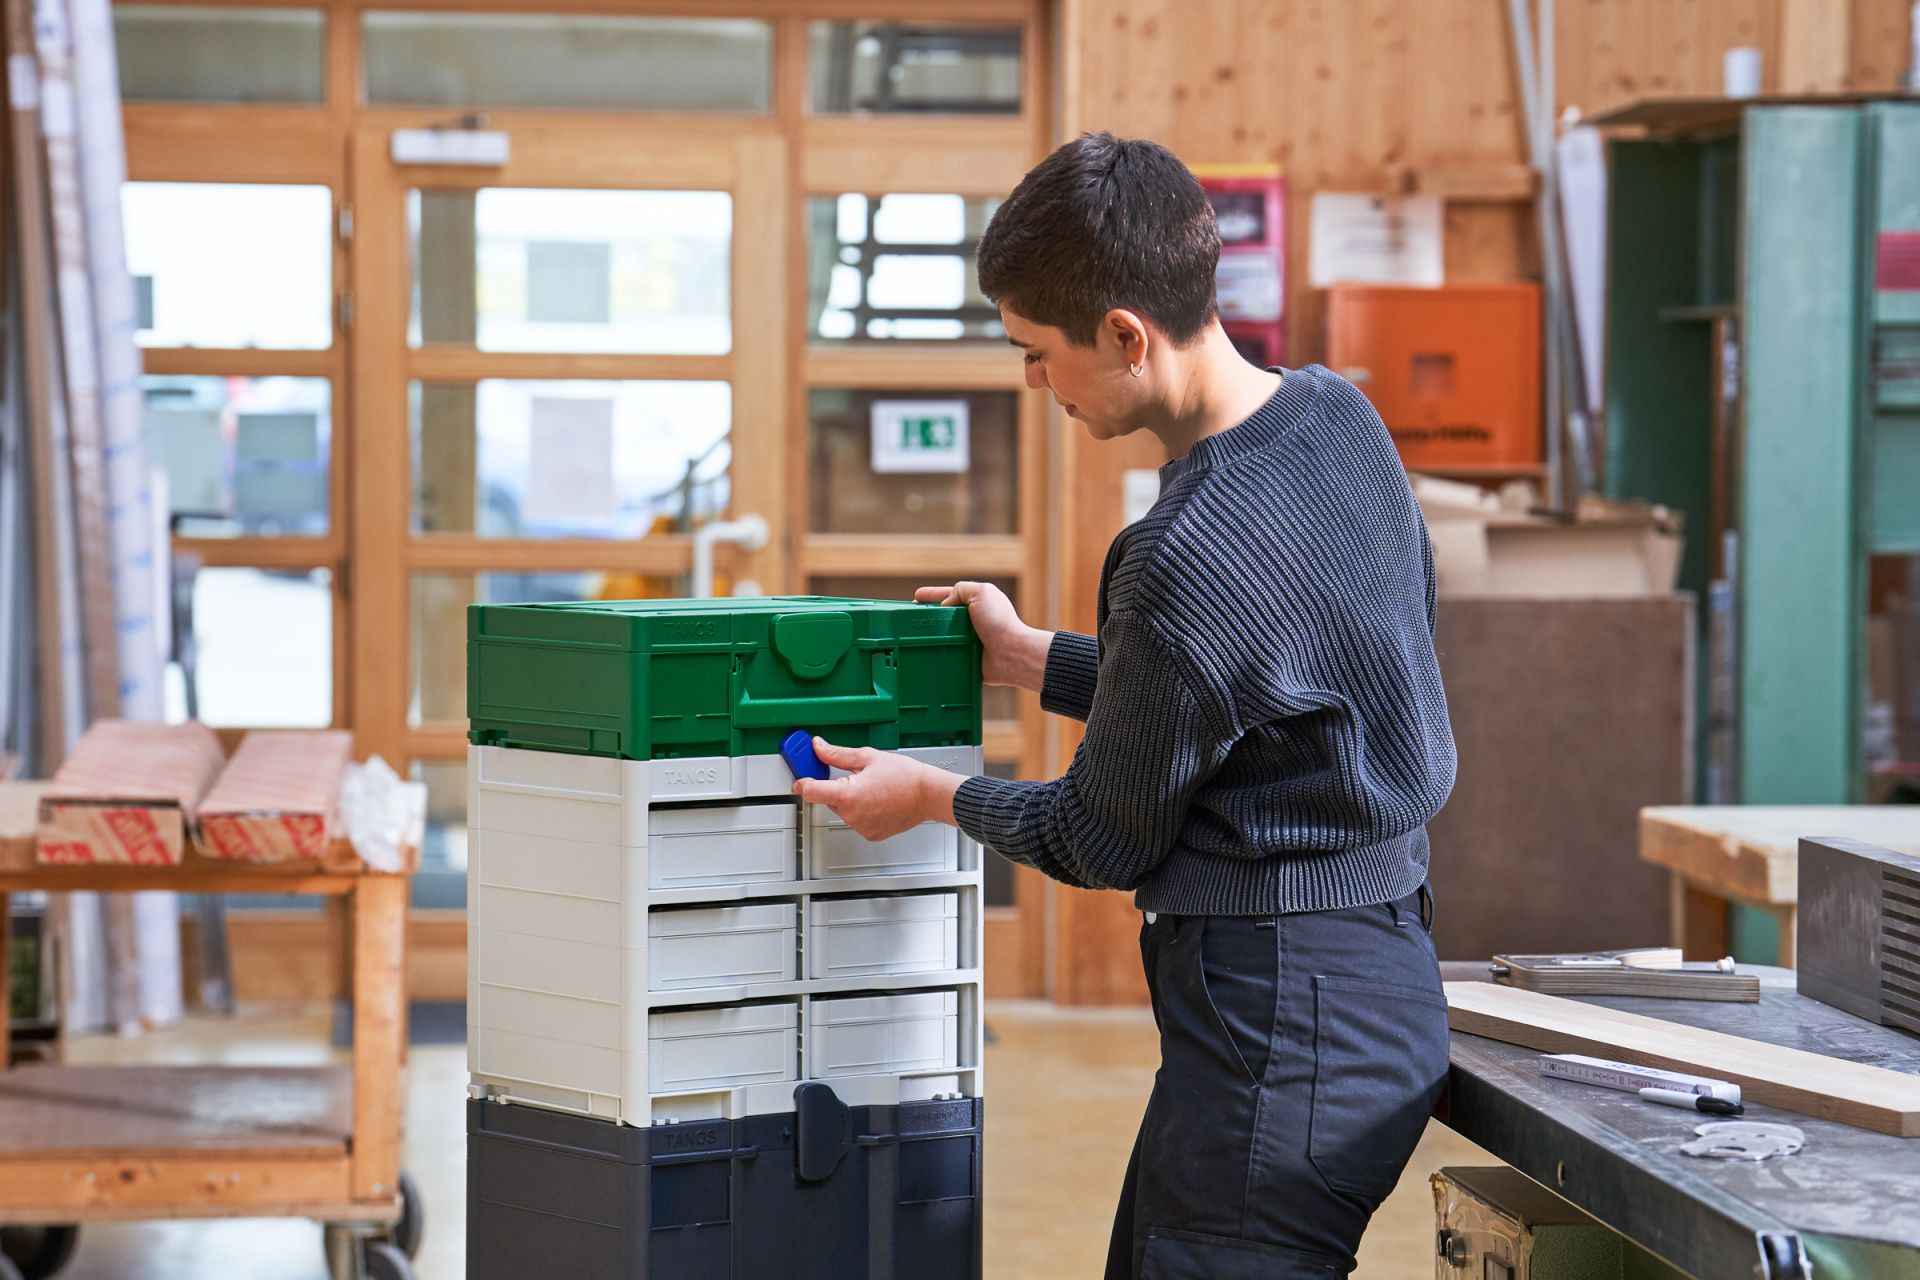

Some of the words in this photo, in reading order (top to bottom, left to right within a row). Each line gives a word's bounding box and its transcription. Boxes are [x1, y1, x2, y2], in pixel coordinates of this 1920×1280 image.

[663, 621, 716, 637] TANOS
[664, 767, 717, 785] TANOS
[664, 1128, 717, 1147] TANOS
